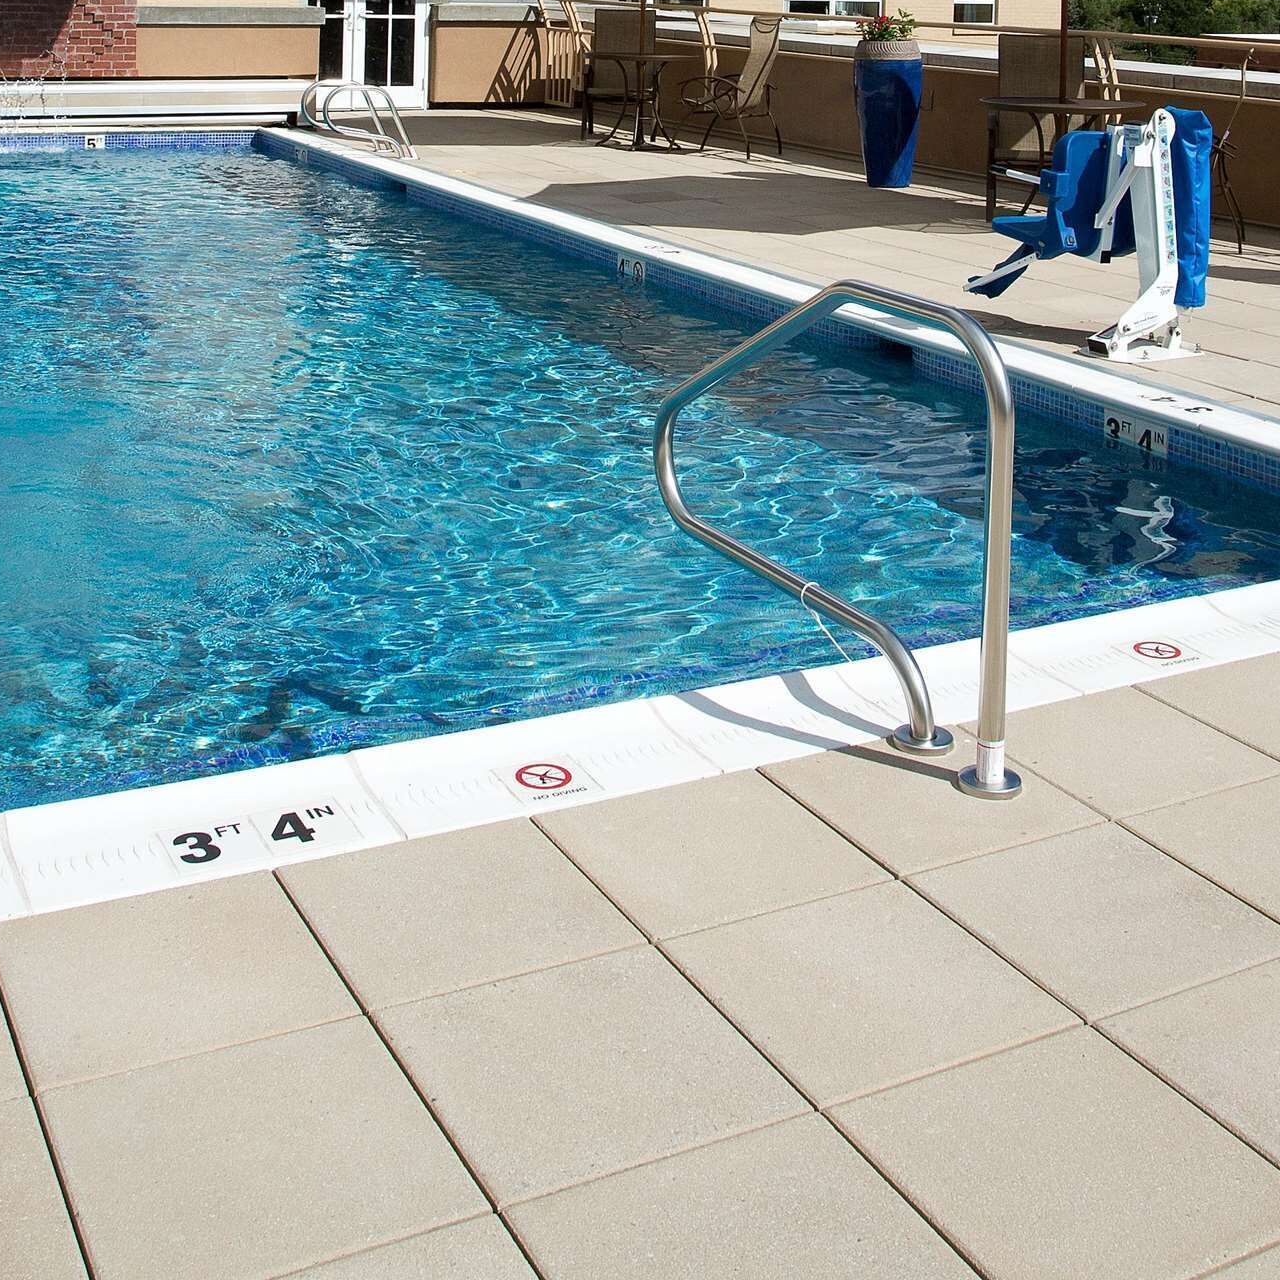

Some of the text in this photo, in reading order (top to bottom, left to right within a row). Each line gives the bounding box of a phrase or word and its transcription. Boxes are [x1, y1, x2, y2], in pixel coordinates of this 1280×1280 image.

[87, 138, 96, 148] 5
[1107, 417, 1120, 439] 3
[1122, 421, 1132, 433] FT
[1154, 431, 1165, 445] IN
[552, 786, 588, 797] DIVING
[173, 805, 335, 863] 3 FT 4 IN
